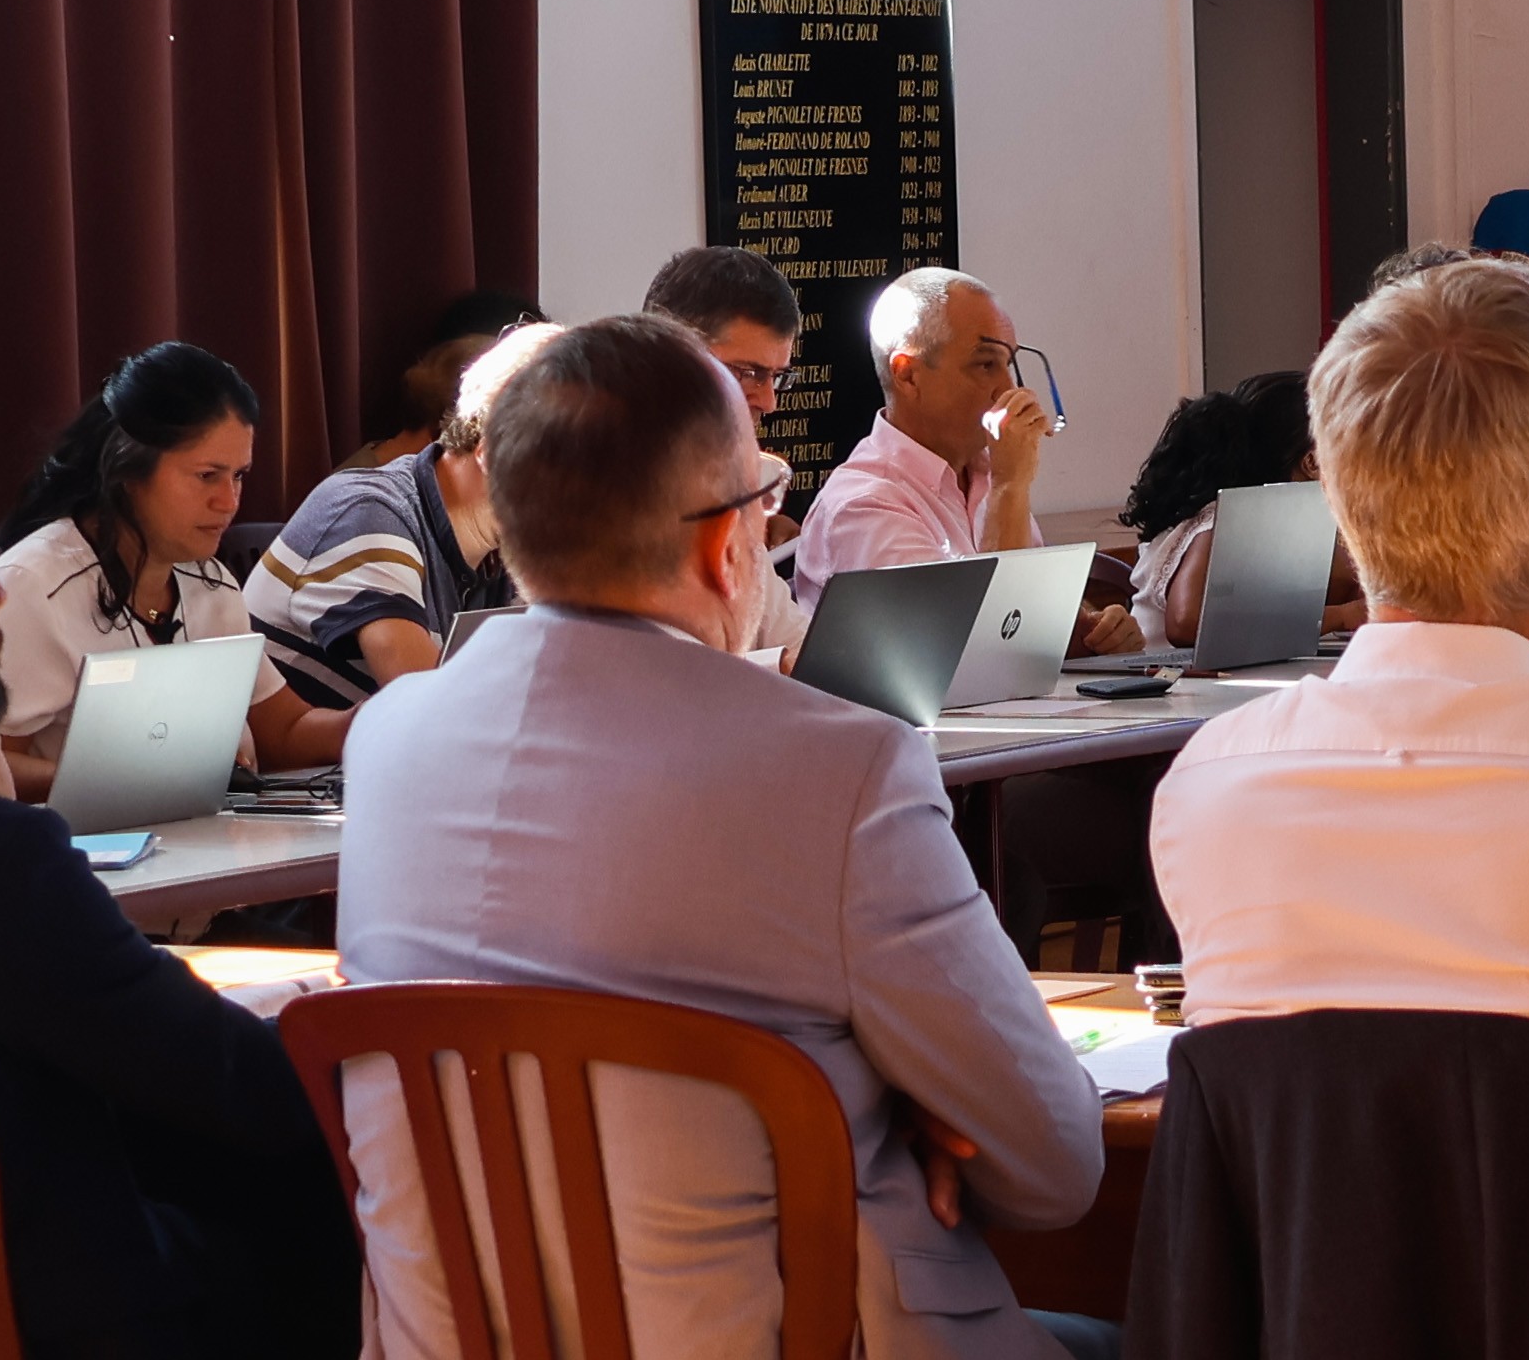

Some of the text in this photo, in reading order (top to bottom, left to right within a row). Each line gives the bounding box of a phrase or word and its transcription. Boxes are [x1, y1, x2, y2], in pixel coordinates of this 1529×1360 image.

[801, 23, 813, 40] DE
[842, 24, 855, 41] CE
[856, 23, 878, 41] JOUR
[758, 53, 811, 71] CHARLETTE
[756, 79, 794, 98] BRUNET
[767, 106, 812, 124] PIGNOLET
[814, 106, 827, 123] DE
[768, 158, 813, 176] PIGNOLET
[815, 158, 828, 175] DE
[763, 210, 833, 228] DE VILLENEUVE
[833, 259, 888, 276] VILLENEUVE
[1001, 608, 1021, 640] hp
